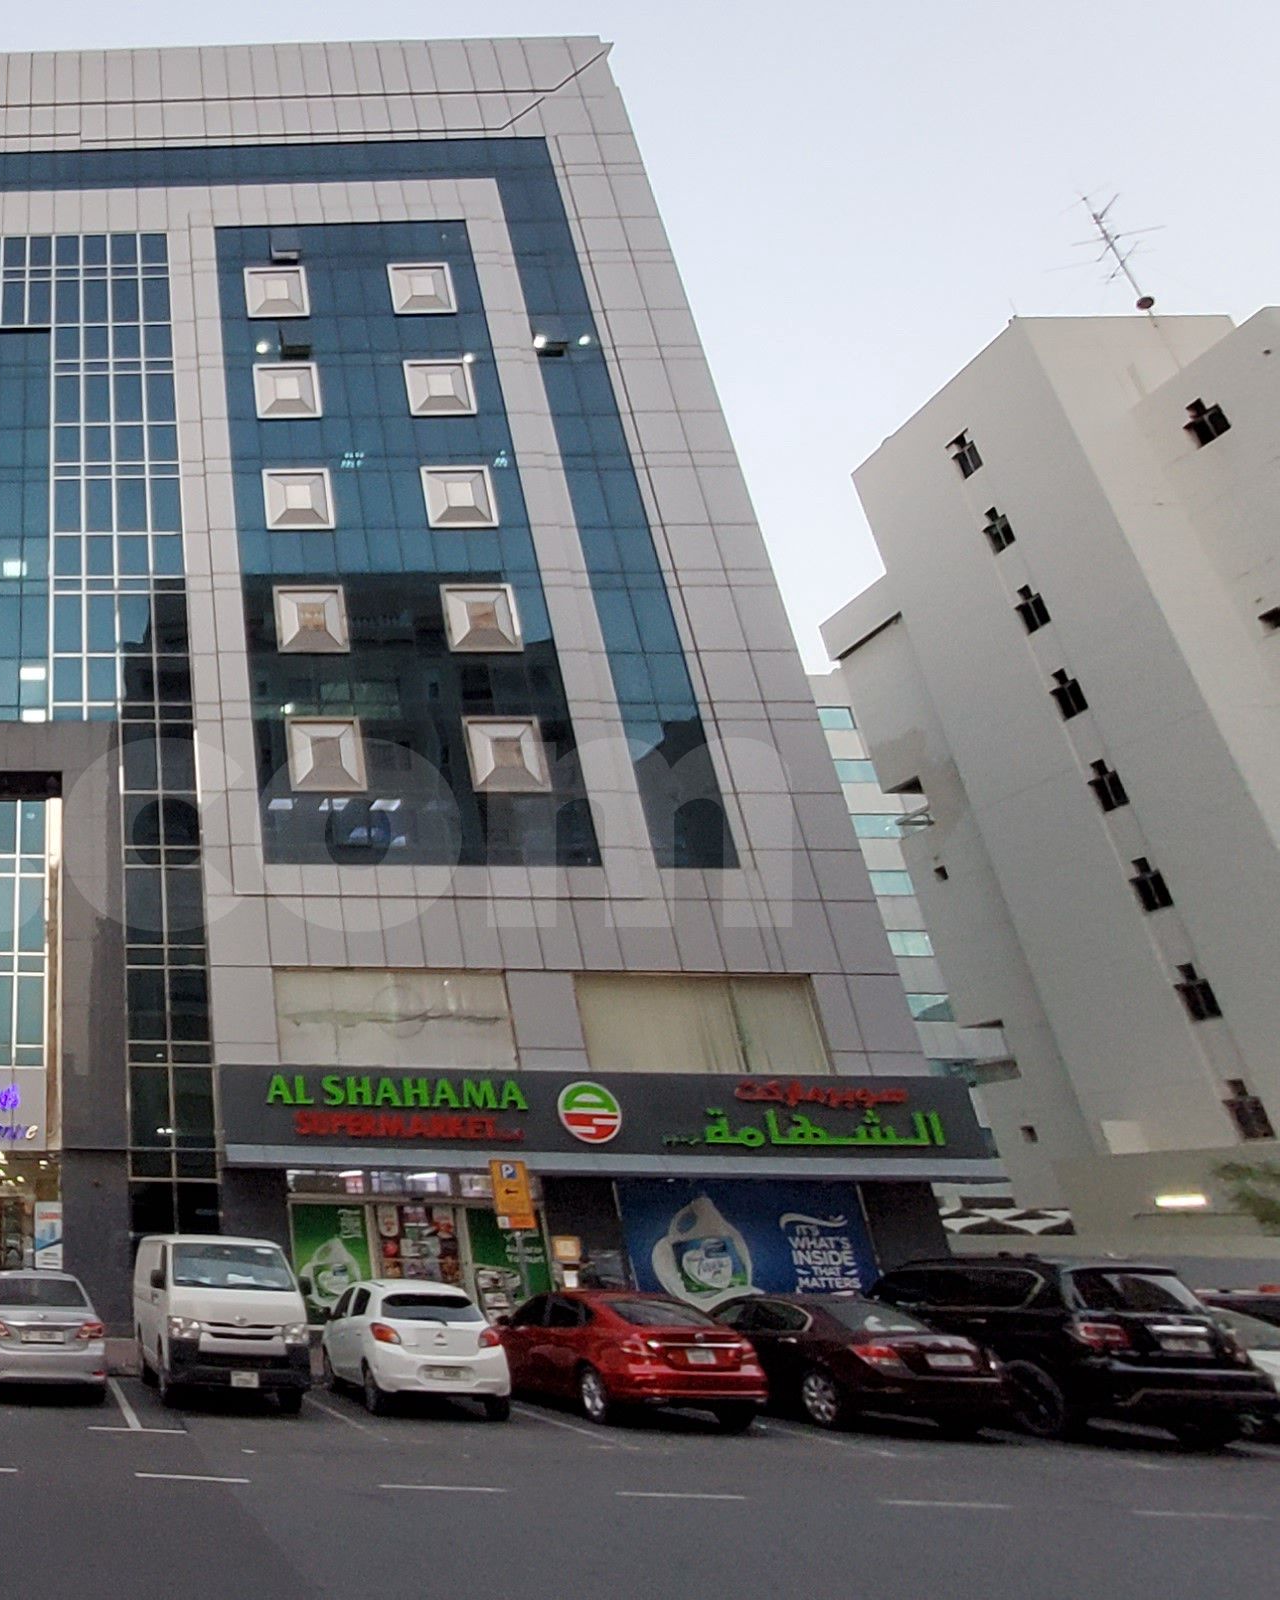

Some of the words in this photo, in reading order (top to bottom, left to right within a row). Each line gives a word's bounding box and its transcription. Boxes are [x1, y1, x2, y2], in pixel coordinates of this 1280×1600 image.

[266, 1074, 314, 1105] AL
[321, 1074, 528, 1110] SHAHAMA
[294, 1110, 496, 1138] SUPERMARKET
[705, 1106, 946, 1147] الشهامة
[788, 1237, 852, 1250] WHAT'S
[792, 1251, 856, 1266] INSIDE
[811, 1266, 841, 1277] THAT
[797, 1277, 862, 1290] MATTERS
